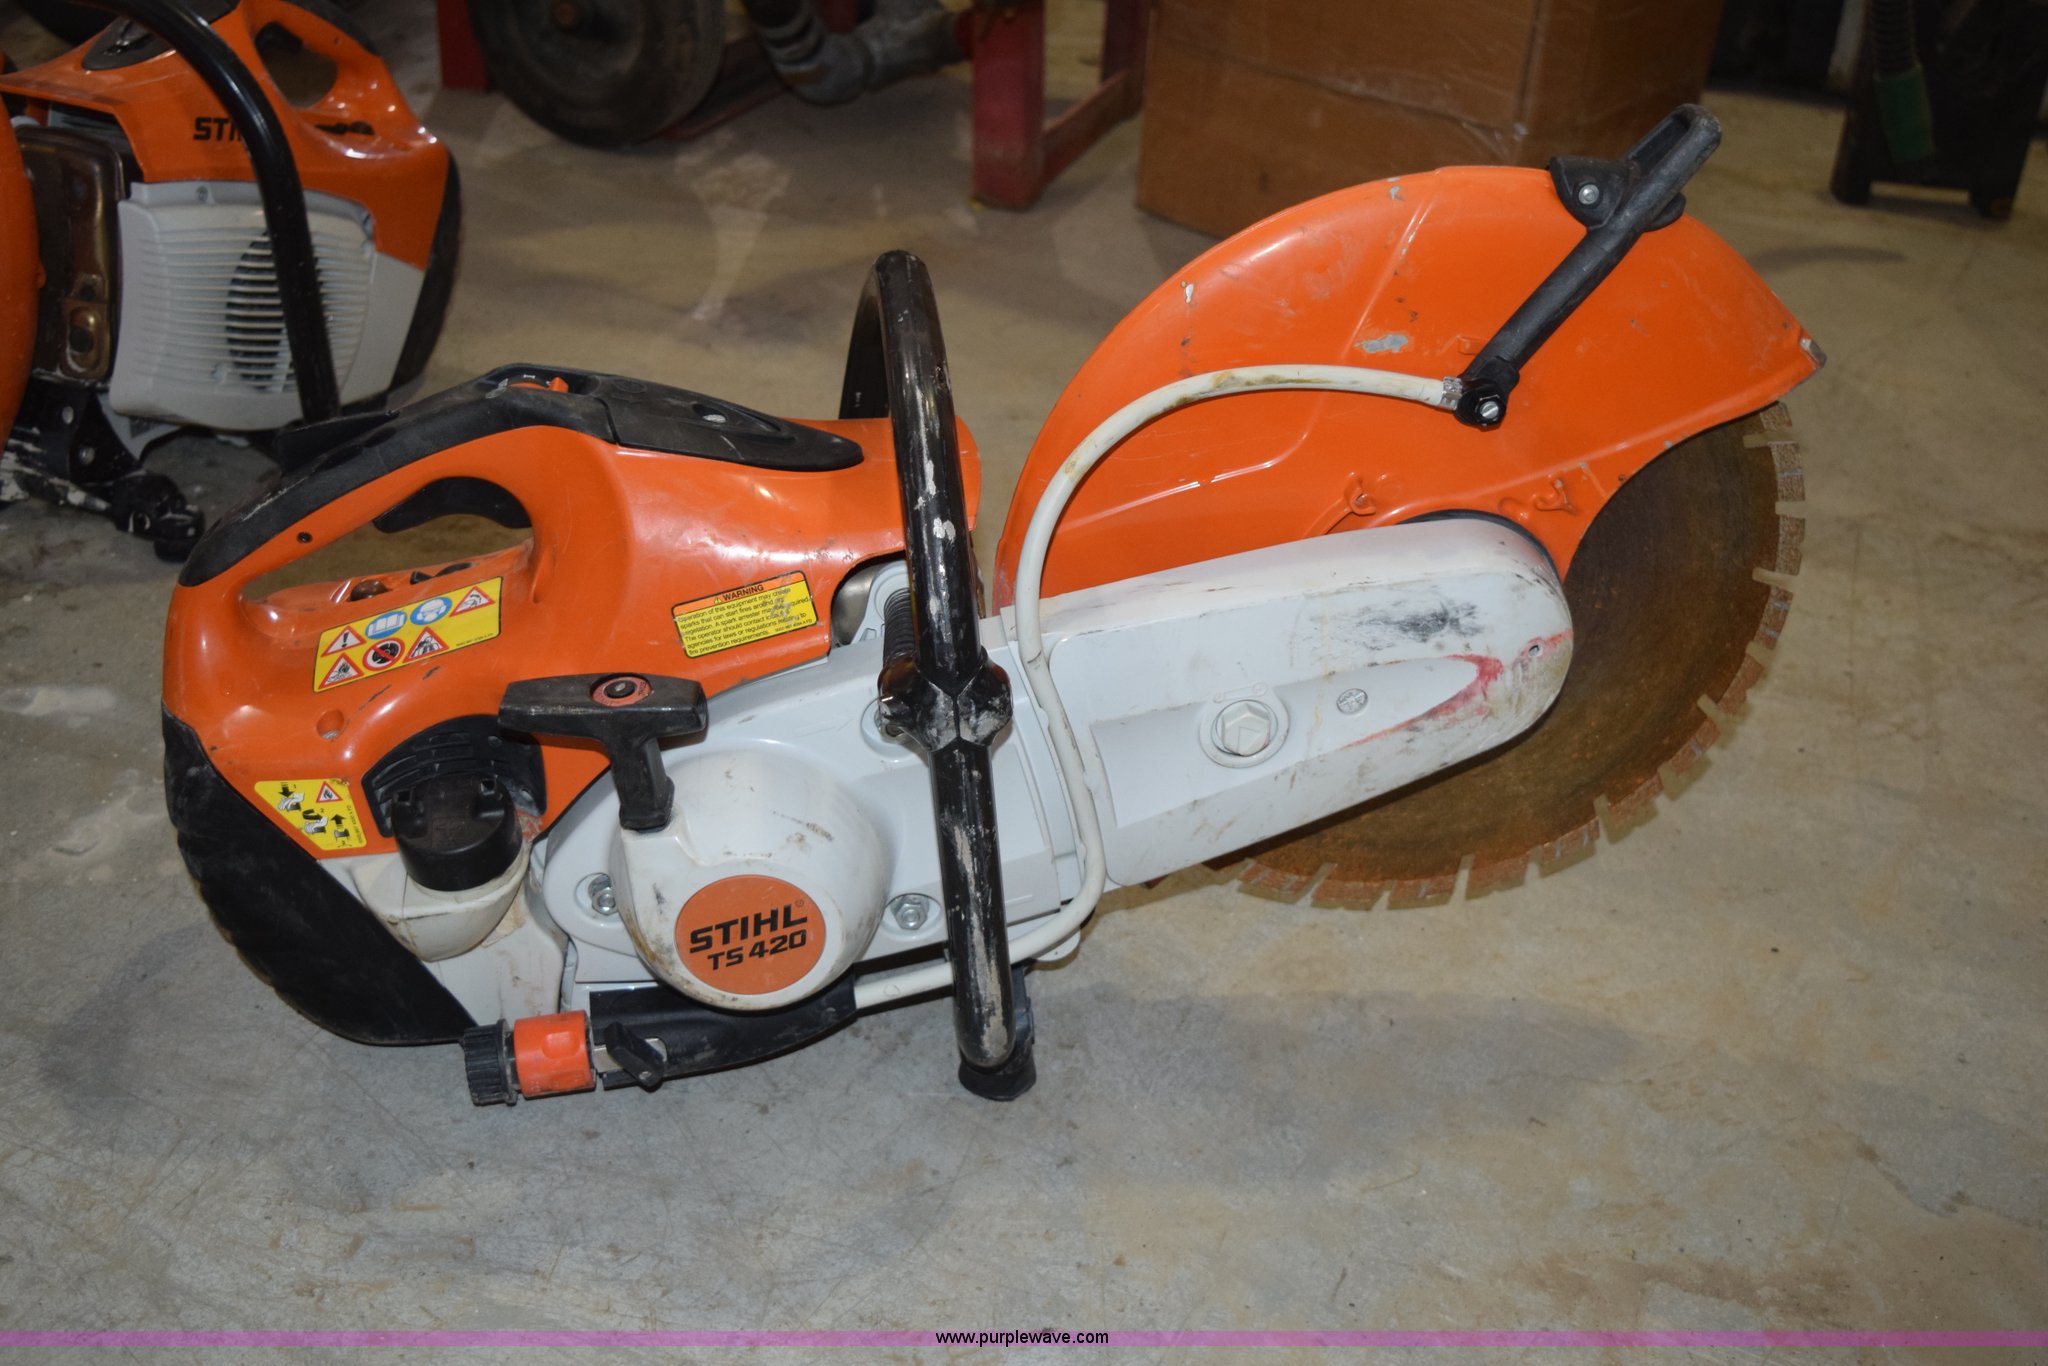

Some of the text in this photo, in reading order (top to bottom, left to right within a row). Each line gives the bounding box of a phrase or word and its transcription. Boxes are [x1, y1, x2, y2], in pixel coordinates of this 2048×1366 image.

[723, 585, 764, 601] WARNING
[725, 609, 738, 617] start
[738, 605, 751, 613] fires
[726, 596, 758, 610] equipment
[697, 628, 721, 639] operator
[722, 622, 742, 632] should
[743, 616, 765, 626] contact
[720, 616, 737, 626] spark
[686, 637, 713, 649] agencies
[745, 620, 777, 634] regulations
[699, 639, 730, 653] prevention
[690, 904, 808, 954] STIHL
[707, 929, 807, 971] TS 420
